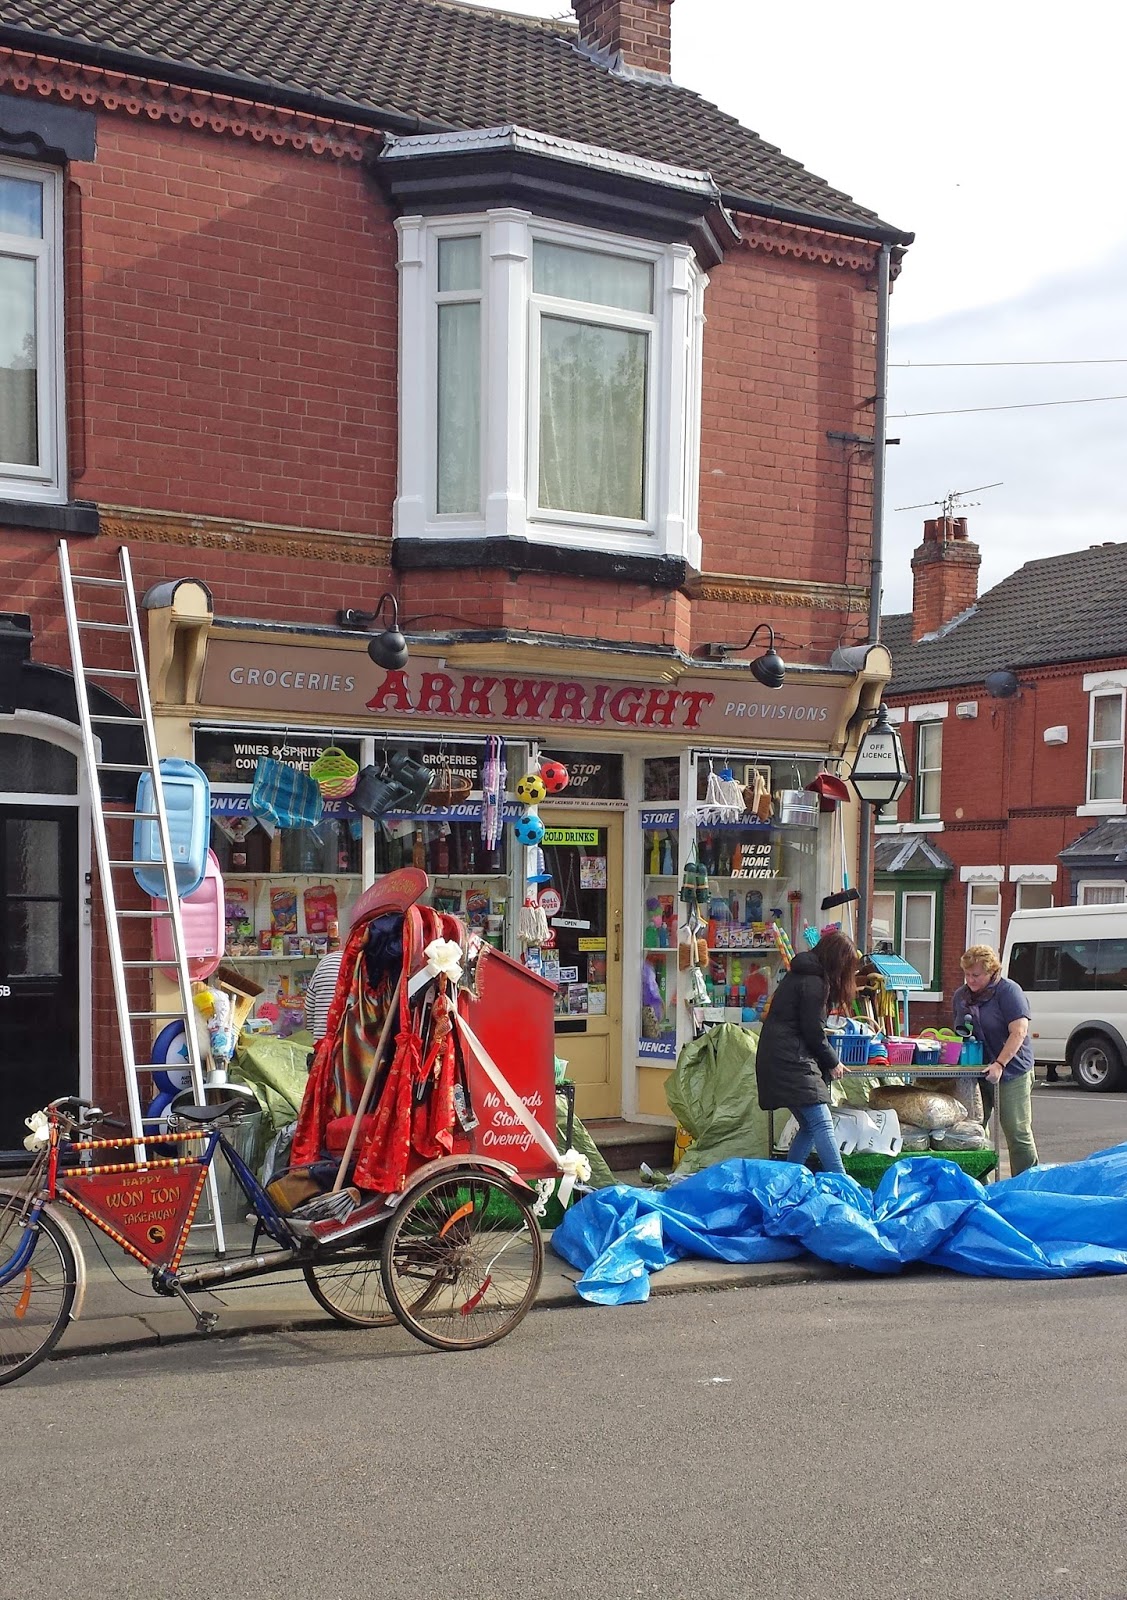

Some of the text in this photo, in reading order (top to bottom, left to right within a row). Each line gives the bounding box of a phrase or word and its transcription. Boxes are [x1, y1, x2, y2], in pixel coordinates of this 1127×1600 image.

[229, 666, 355, 693] GROCERIES
[365, 669, 715, 731] ARKWRIGHT
[724, 701, 828, 722] PROVISIONS
[234, 743, 324, 758] WINES & SPIRITS
[422, 754, 478, 766] GROCERIES
[571, 763, 602, 775] STOP
[566, 775, 589, 787] HOP
[641, 812, 676, 824] STORE
[543, 831, 595, 842] COLD DRINKS
[741, 844, 772, 855] WE DO
[741, 856, 770, 867] HOME
[730, 868, 780, 879] DELIVERY
[483, 1090, 544, 1108] No ods
[122, 1175, 161, 1187] HAPPY
[105, 1186, 180, 1208] WON TON
[122, 1207, 177, 1226] TAKEAWAY
